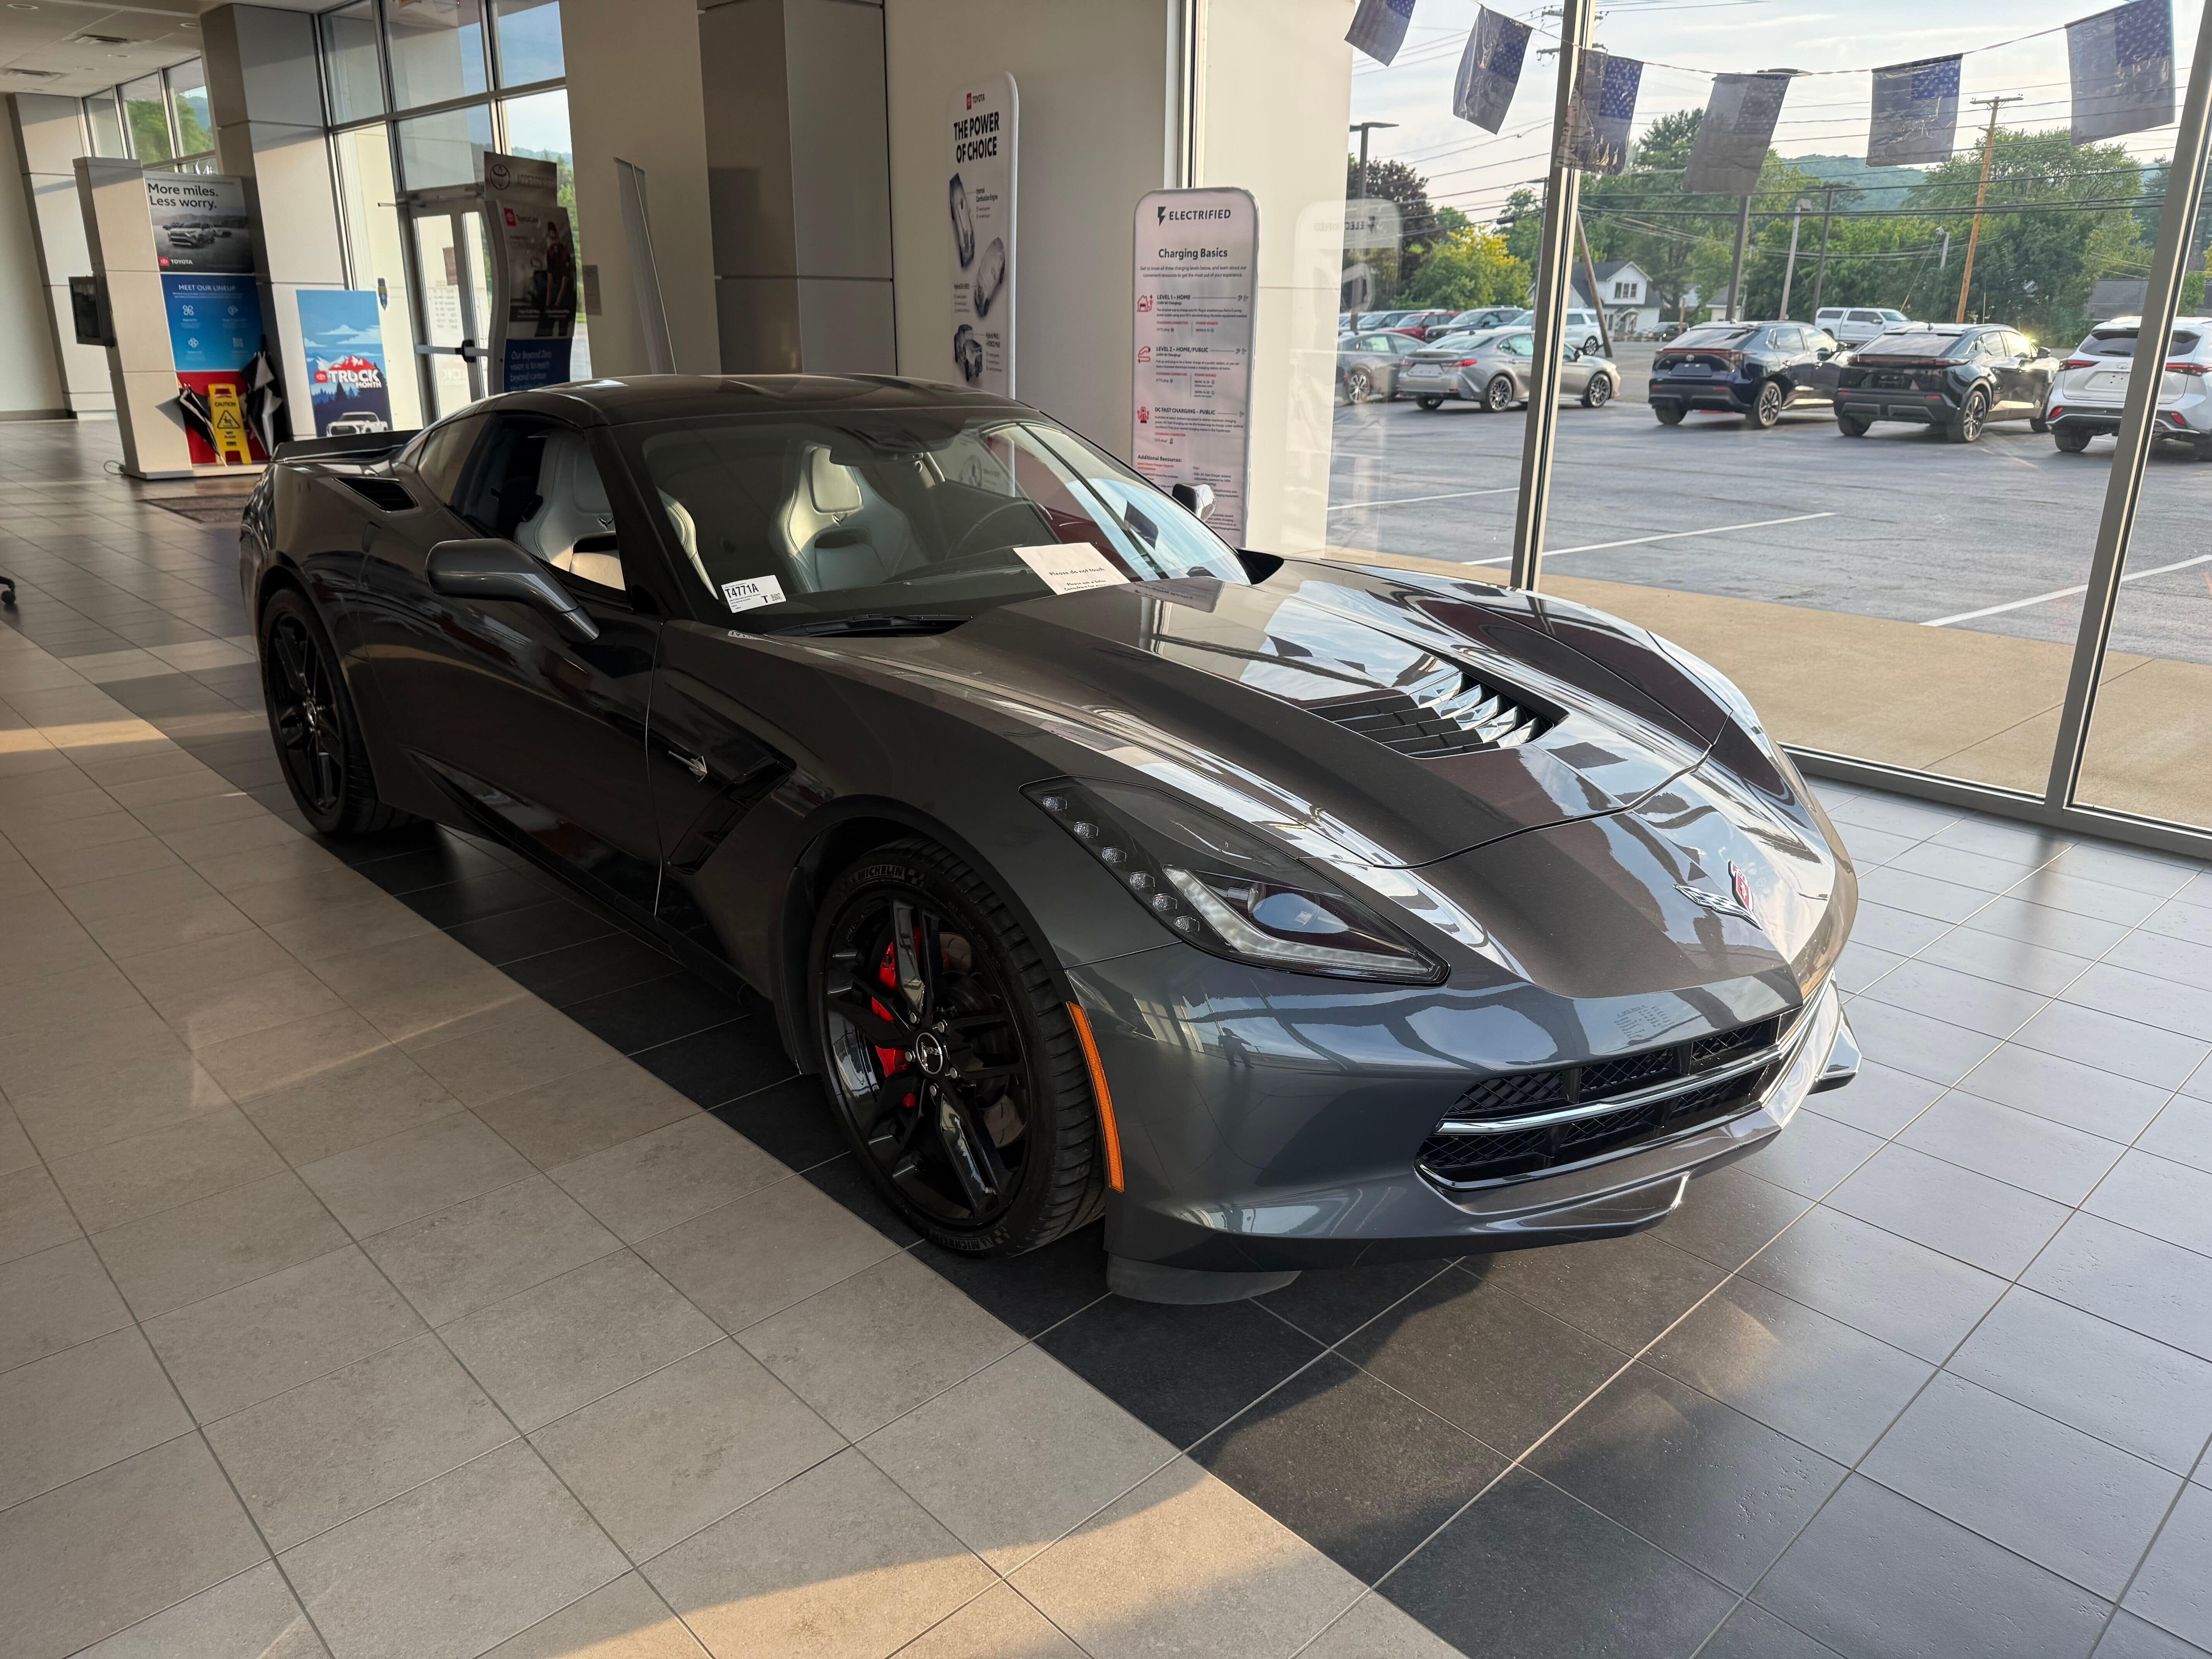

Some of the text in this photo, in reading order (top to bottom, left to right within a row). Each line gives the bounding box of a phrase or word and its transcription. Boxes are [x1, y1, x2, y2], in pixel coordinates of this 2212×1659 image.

[972, 93, 985, 104] TOYOTA
[954, 112, 1000, 141] THE POWER
[956, 136, 997, 164] OF CHOICE
[148, 183, 218, 197] More miles.
[150, 196, 217, 210] Less worry.
[1169, 209, 1231, 220] ELECTRIFIED
[1158, 247, 1228, 260] Charging Basics
[329, 369, 379, 383] TRUCK
[725, 584, 759, 598] T4771A
[761, 595, 768, 603] T
[858, 865, 903, 880] MICHELIN
